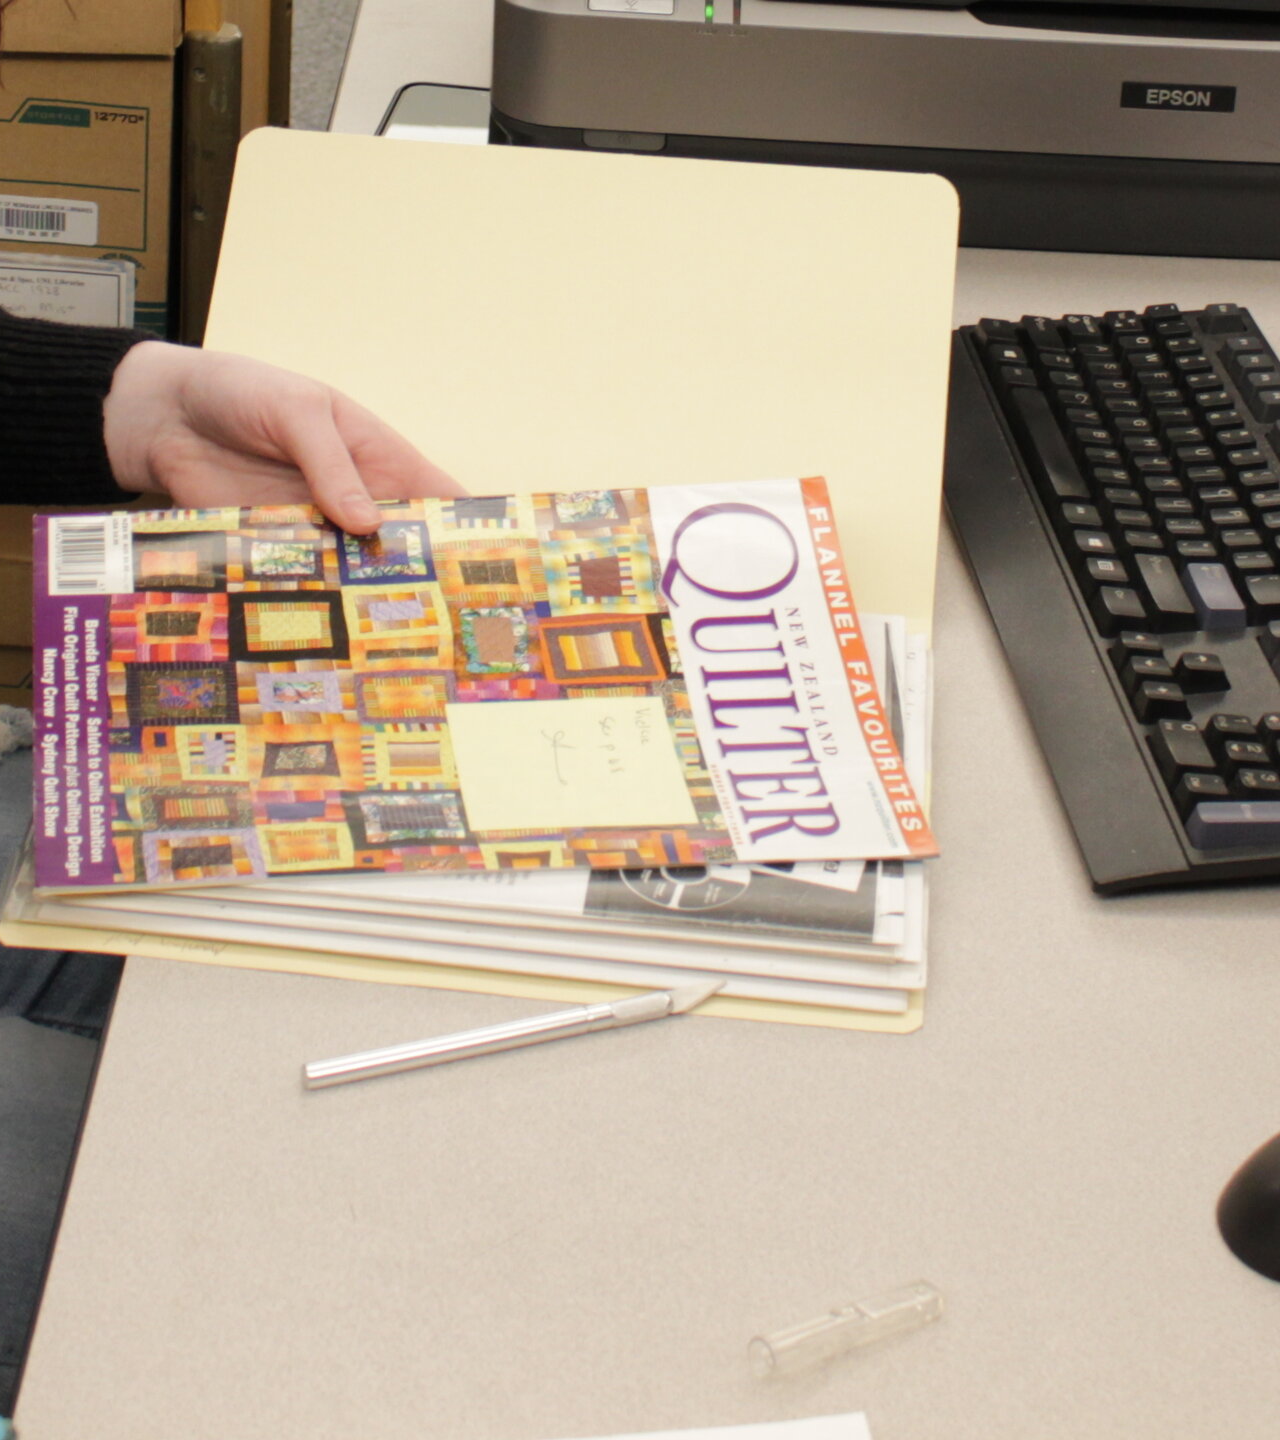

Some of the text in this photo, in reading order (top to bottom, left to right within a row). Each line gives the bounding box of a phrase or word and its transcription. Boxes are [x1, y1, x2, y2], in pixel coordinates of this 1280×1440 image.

[1146, 88, 1212, 107] EPSON
[40, 648, 60, 837] Nancy Crow Sydney Quilt Show
[61, 606, 84, 877] Five Original Quilt Patterns plus Quilting Design
[84, 618, 106, 863] Brenda Visser Salute to Quilts Exhibition
[661, 502, 841, 845] QUILTER
[784, 607, 839, 756] NEW ZEALAND
[809, 507, 923, 832] FLANNEL FAVOURITES
